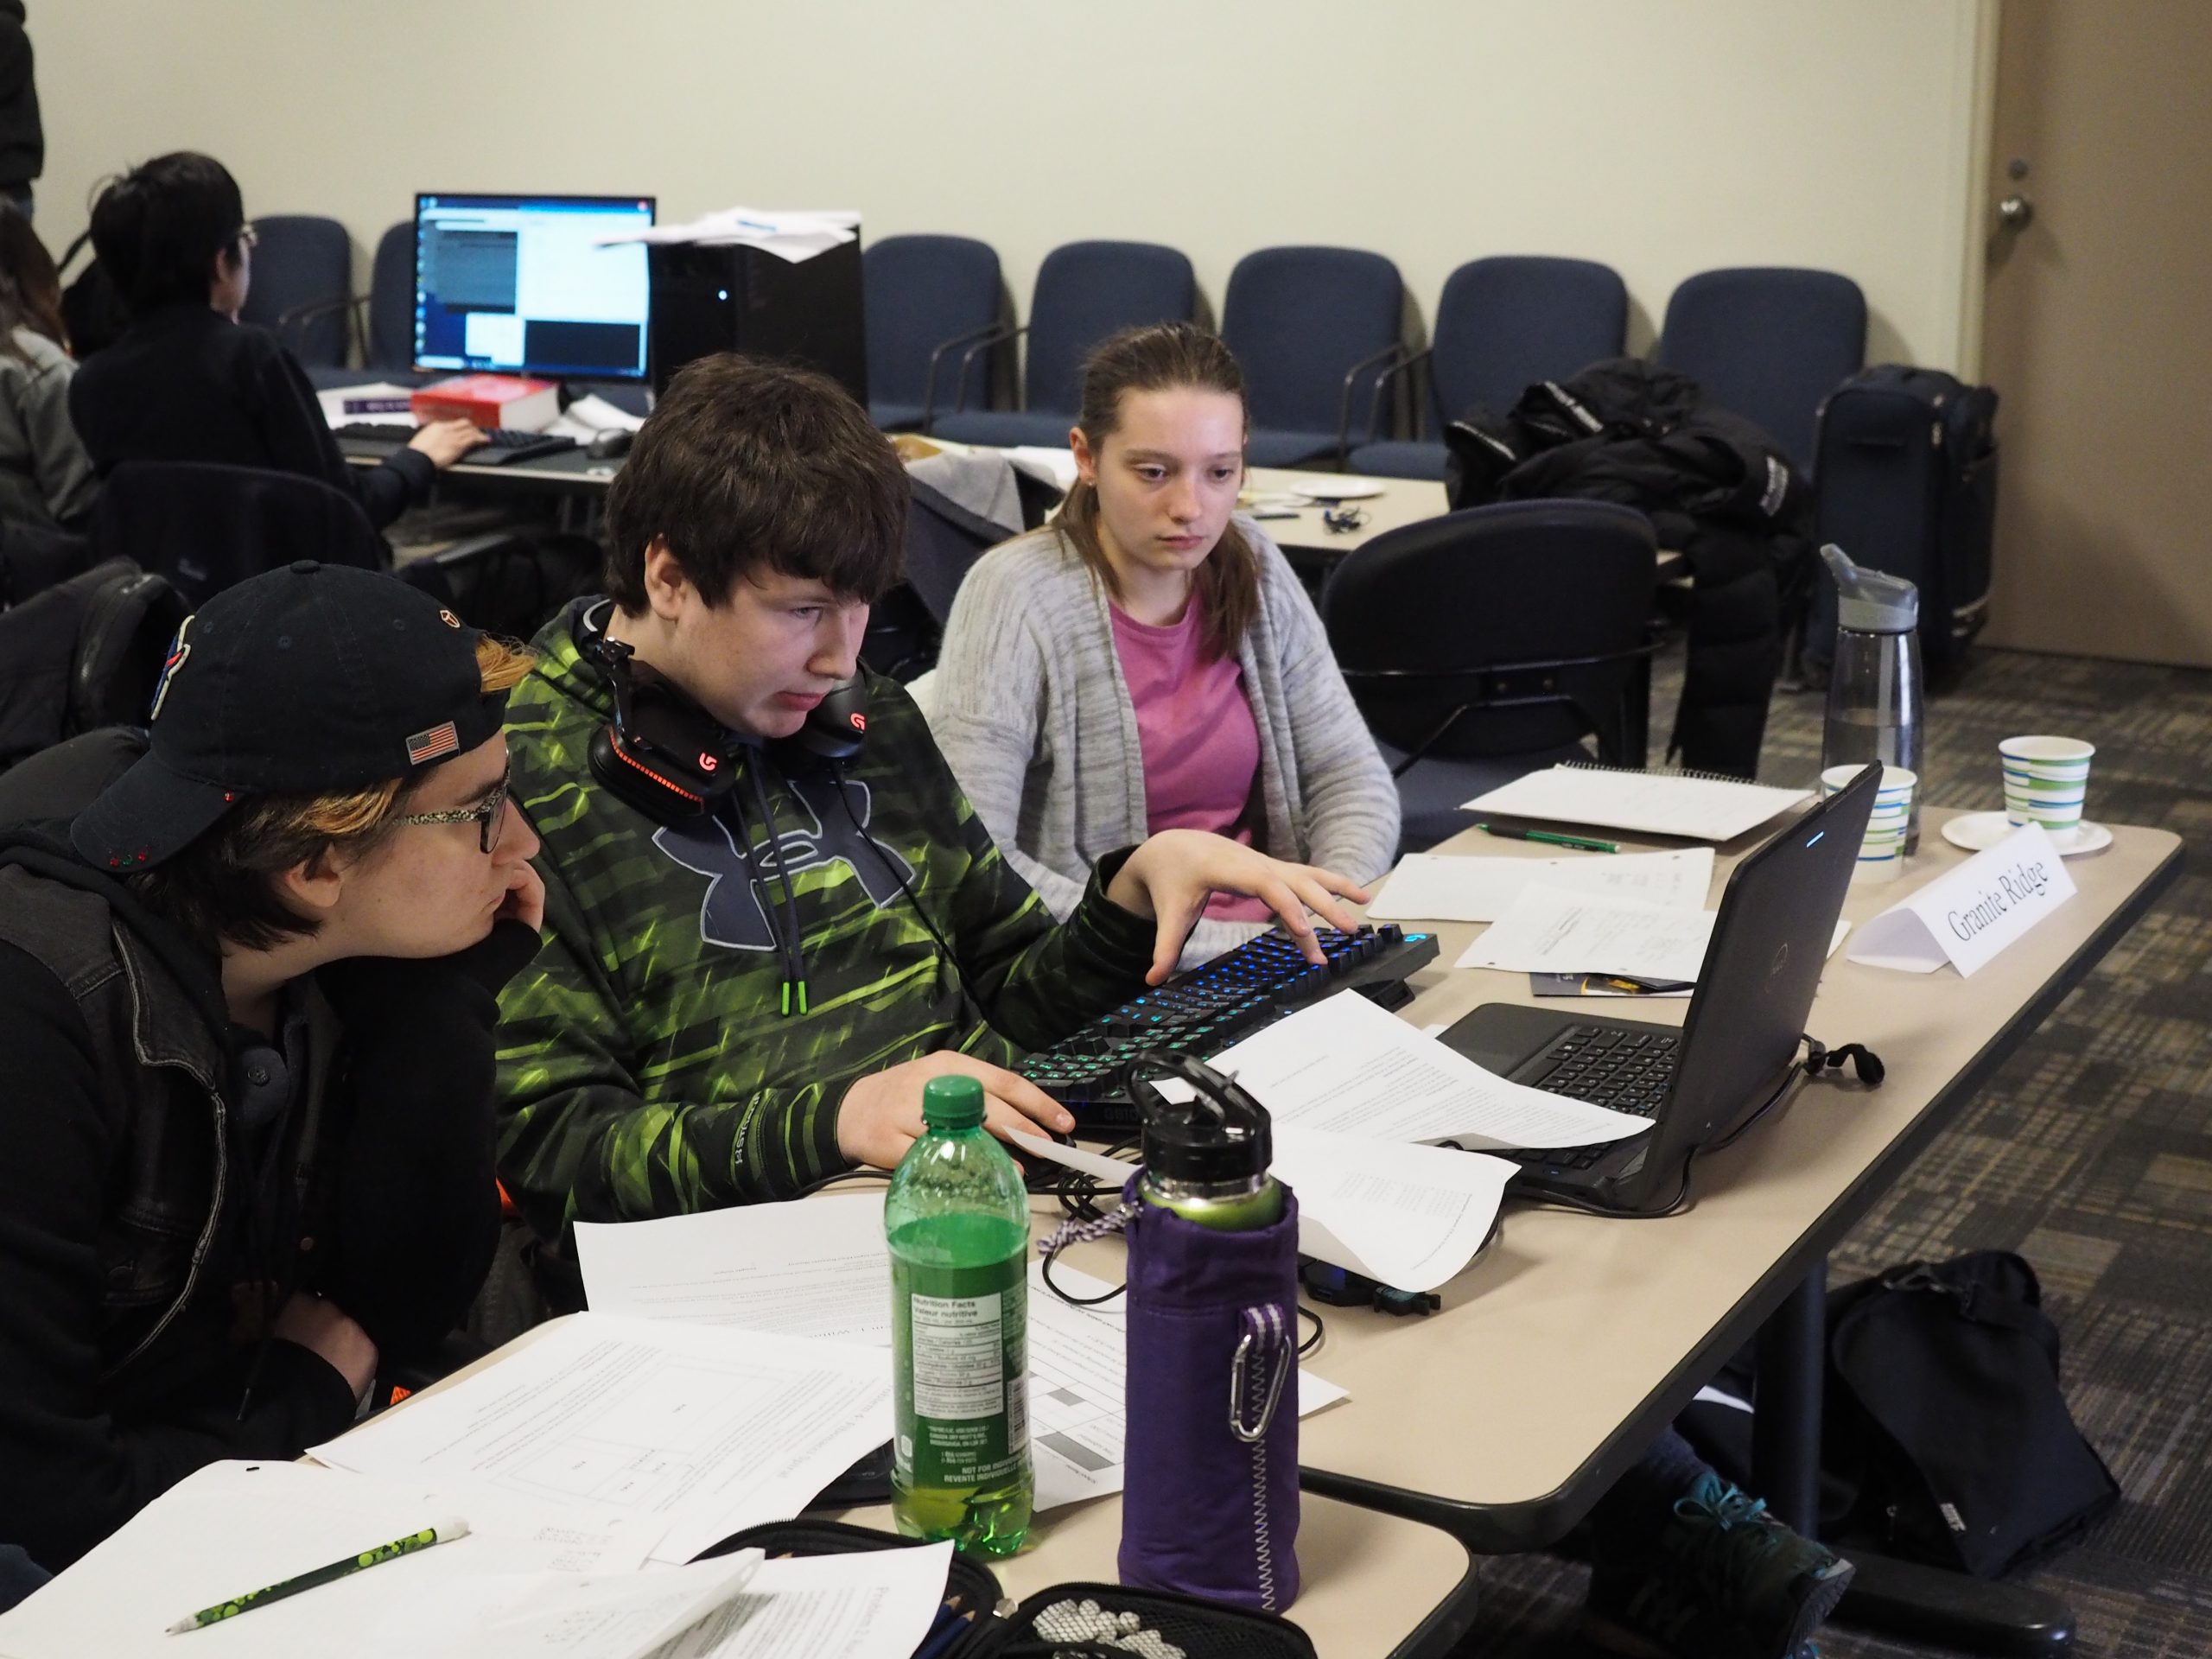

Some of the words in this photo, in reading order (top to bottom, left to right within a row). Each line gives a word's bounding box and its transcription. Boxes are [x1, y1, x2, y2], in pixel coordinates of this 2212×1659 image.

[1948, 890, 2007, 942] Granite
[1998, 861, 2049, 906] Ridge
[914, 1307, 938, 1317] Valeur
[962, 1466, 976, 1475] NOT
[977, 1464, 992, 1473] FOR
[944, 1474, 976, 1483] REVENTE
